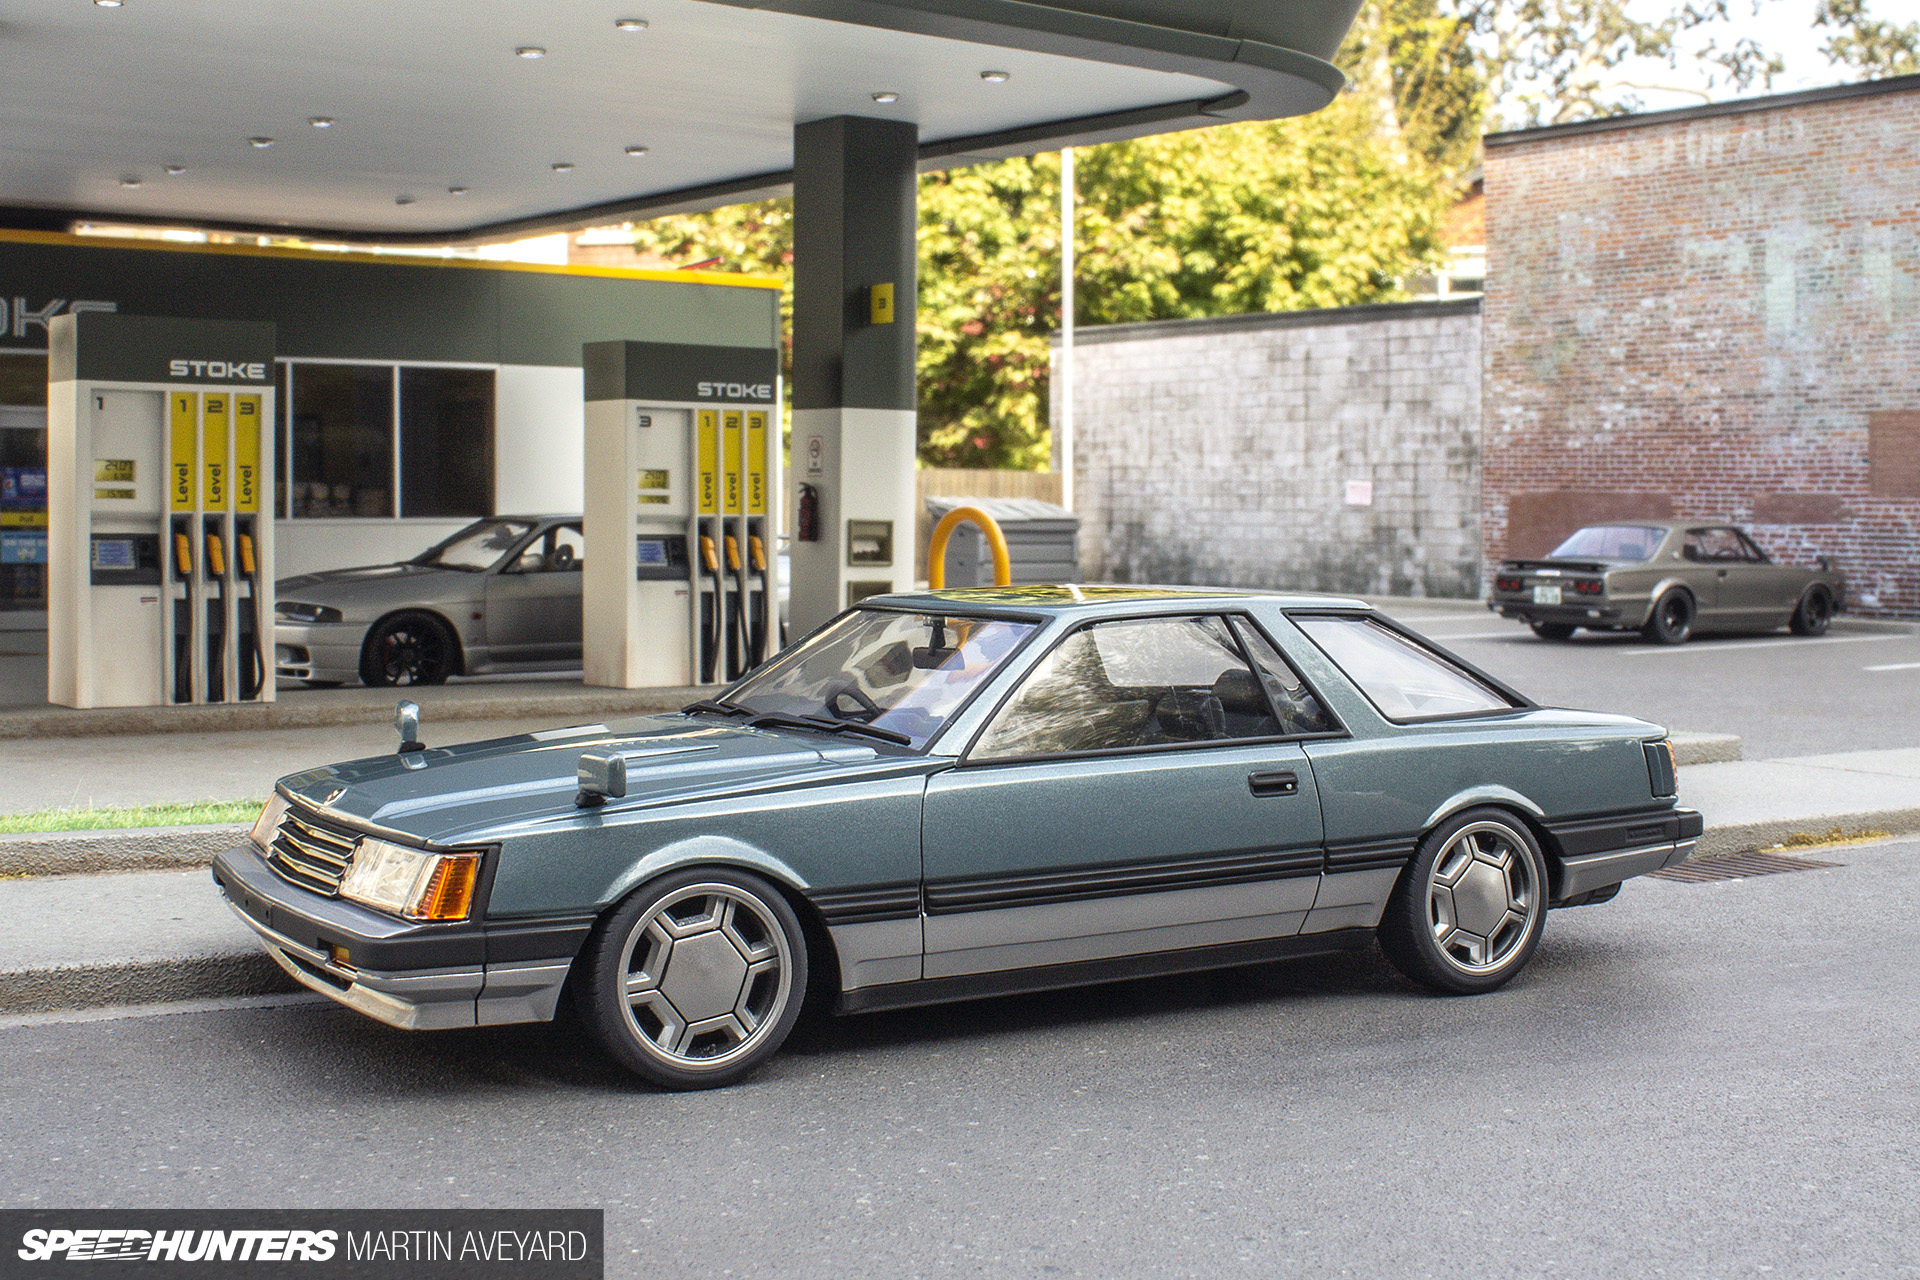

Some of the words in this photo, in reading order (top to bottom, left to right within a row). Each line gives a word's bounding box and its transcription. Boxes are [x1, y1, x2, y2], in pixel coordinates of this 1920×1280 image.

[169, 359, 266, 379] STOKE
[697, 382, 771, 398] STOKE
[96, 397, 104, 410] 1
[179, 399, 187, 412] 1
[207, 400, 223, 413] 2
[239, 402, 254, 415] 3
[639, 416, 651, 427] 3
[704, 416, 711, 427] 1
[725, 417, 738, 428] 2
[750, 417, 762, 428] 3
[175, 463, 188, 503] Level
[208, 464, 221, 503] Level
[240, 465, 252, 504] Level
[702, 472, 712, 507] Level
[727, 473, 737, 507] Level
[750, 473, 760, 507] Level
